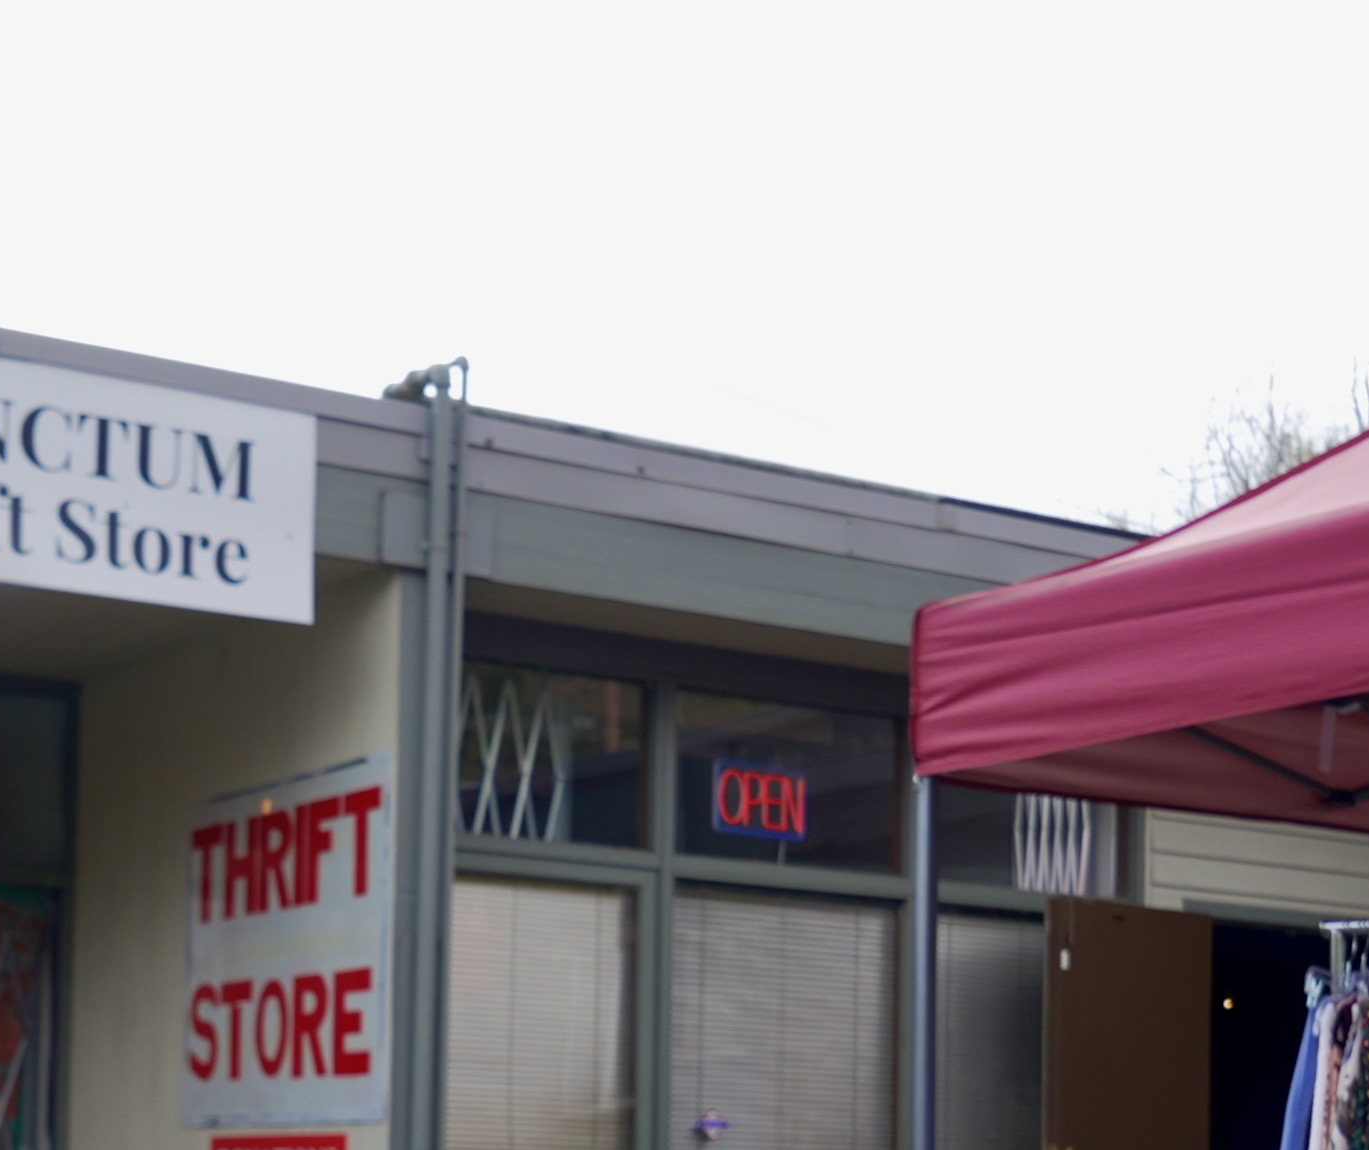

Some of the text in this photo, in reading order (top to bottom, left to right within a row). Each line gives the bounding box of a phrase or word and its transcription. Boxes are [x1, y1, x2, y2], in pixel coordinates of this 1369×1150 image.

[55, 497, 248, 586] Store
[719, 768, 806, 834] OPEN
[191, 785, 382, 923] THRIFT
[188, 967, 372, 1083] STORE
